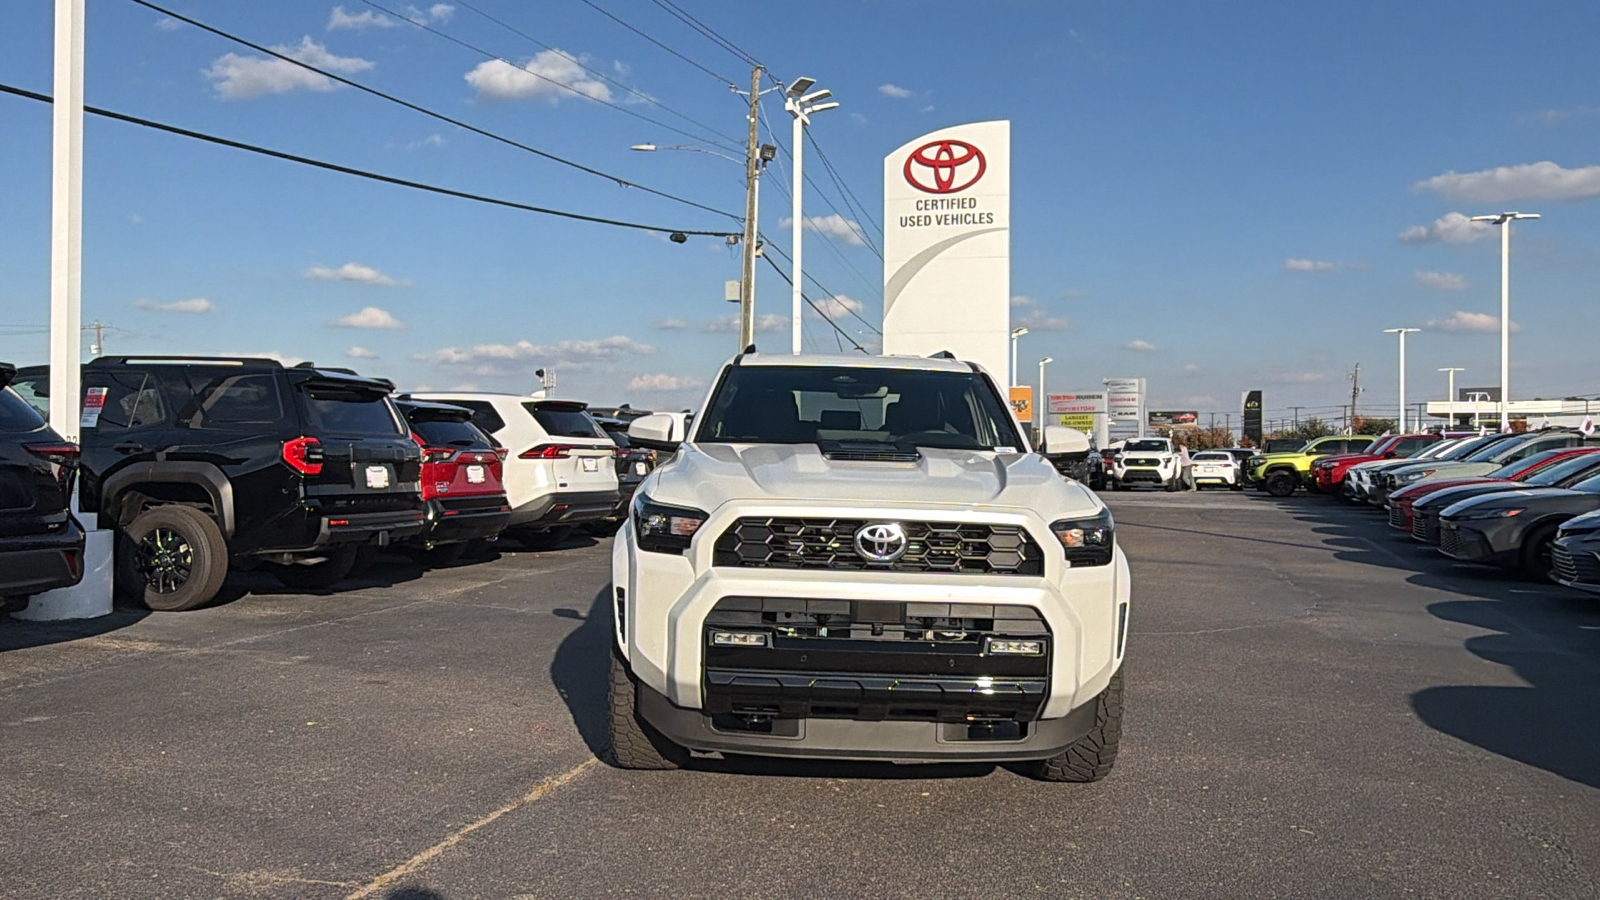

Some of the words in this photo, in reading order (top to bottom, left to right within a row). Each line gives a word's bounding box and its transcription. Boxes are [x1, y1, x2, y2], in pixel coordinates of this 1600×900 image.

[916, 197, 977, 211] CERTIFIED
[900, 215, 932, 228] USED
[935, 212, 994, 226] VEHICLES
